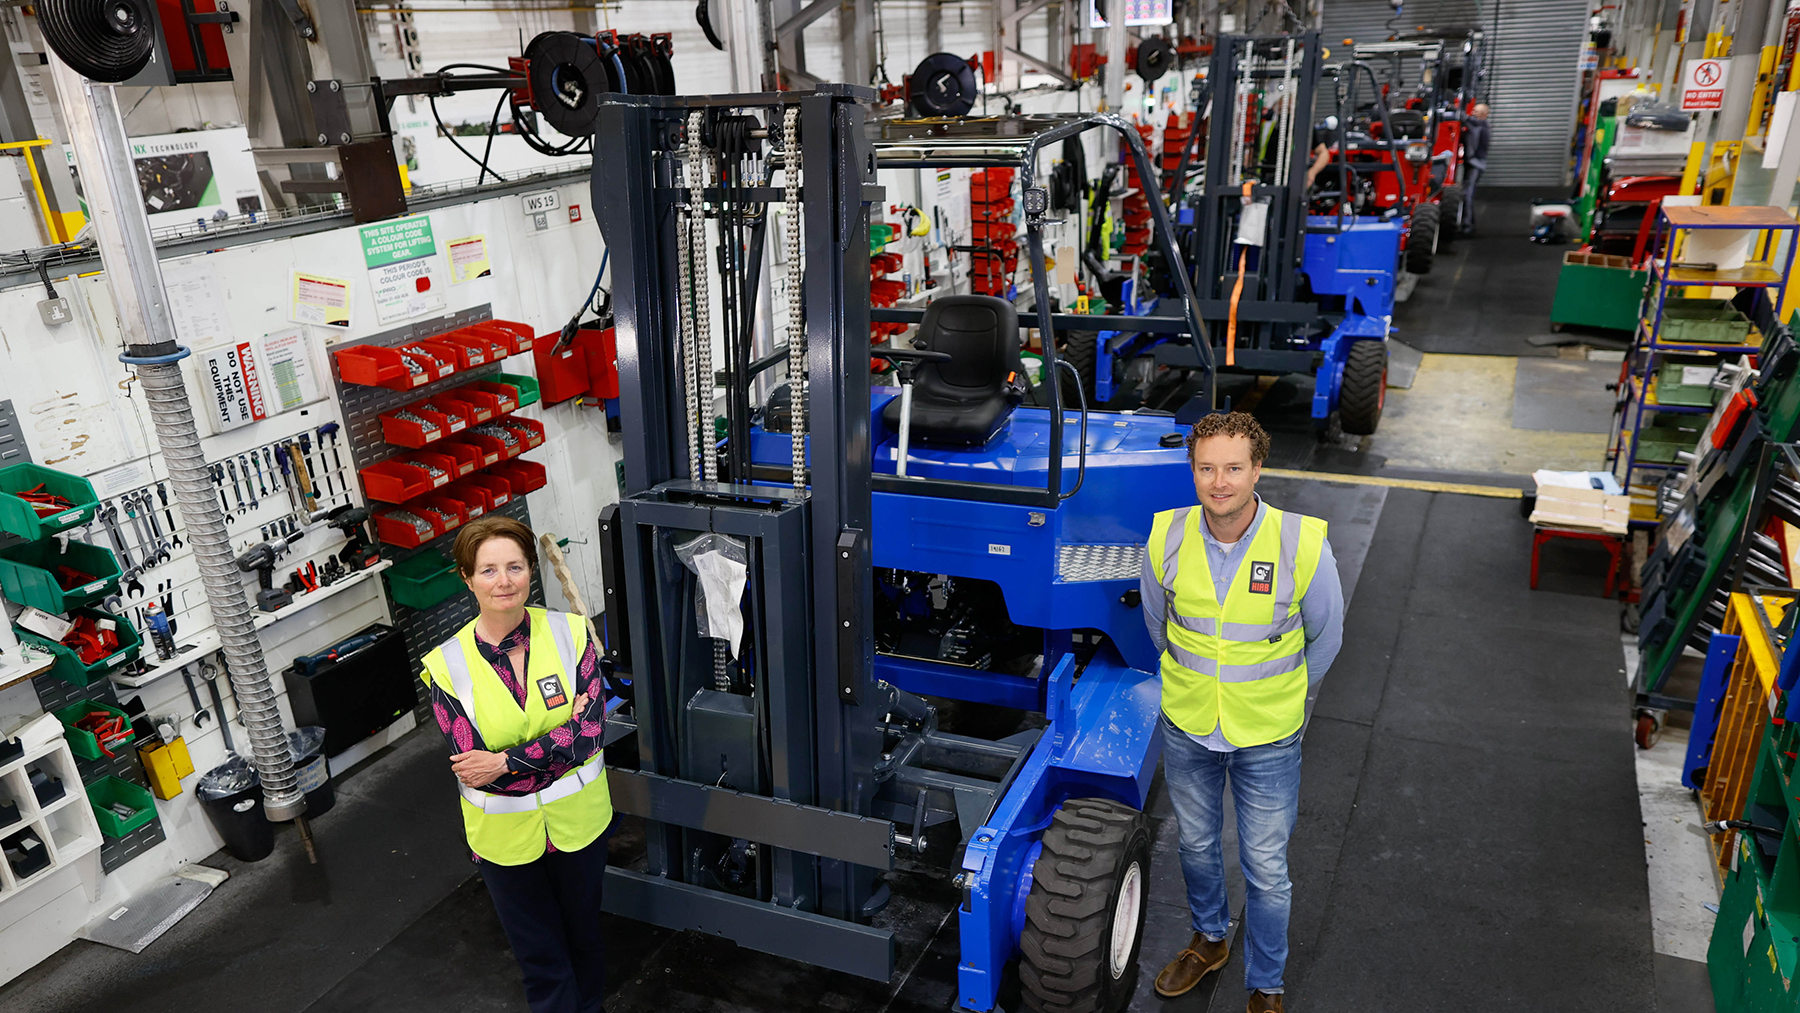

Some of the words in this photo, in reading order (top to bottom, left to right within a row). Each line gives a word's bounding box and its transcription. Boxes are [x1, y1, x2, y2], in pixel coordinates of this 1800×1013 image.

[151, 142, 198, 154] TECHNOLOGY
[528, 198, 542, 210] WS
[544, 195, 554, 207] 19
[364, 229, 380, 238] THIS
[381, 226, 395, 235] SITE
[396, 219, 428, 232] OPERATES
[378, 232, 404, 244] COLOUR
[405, 229, 423, 238] CODE
[367, 244, 394, 255] SYSTEM
[394, 240, 408, 250] FOR
[408, 236, 432, 247] LIFTING
[392, 249, 412, 259] GEAR.
[398, 260, 427, 272] PERIOD'S
[380, 274, 406, 284] COLOUR
[407, 269, 423, 278] CODE
[223, 376, 234, 402] THIS
[227, 351, 237, 368] DO
[232, 371, 243, 394] NOT
[238, 398, 249, 420] USE
[241, 346, 265, 417] WARNING
[209, 358, 231, 423] EQUIPMENT
[1251, 582, 1270, 592] HIAB
[546, 694, 565, 708] HIAB
